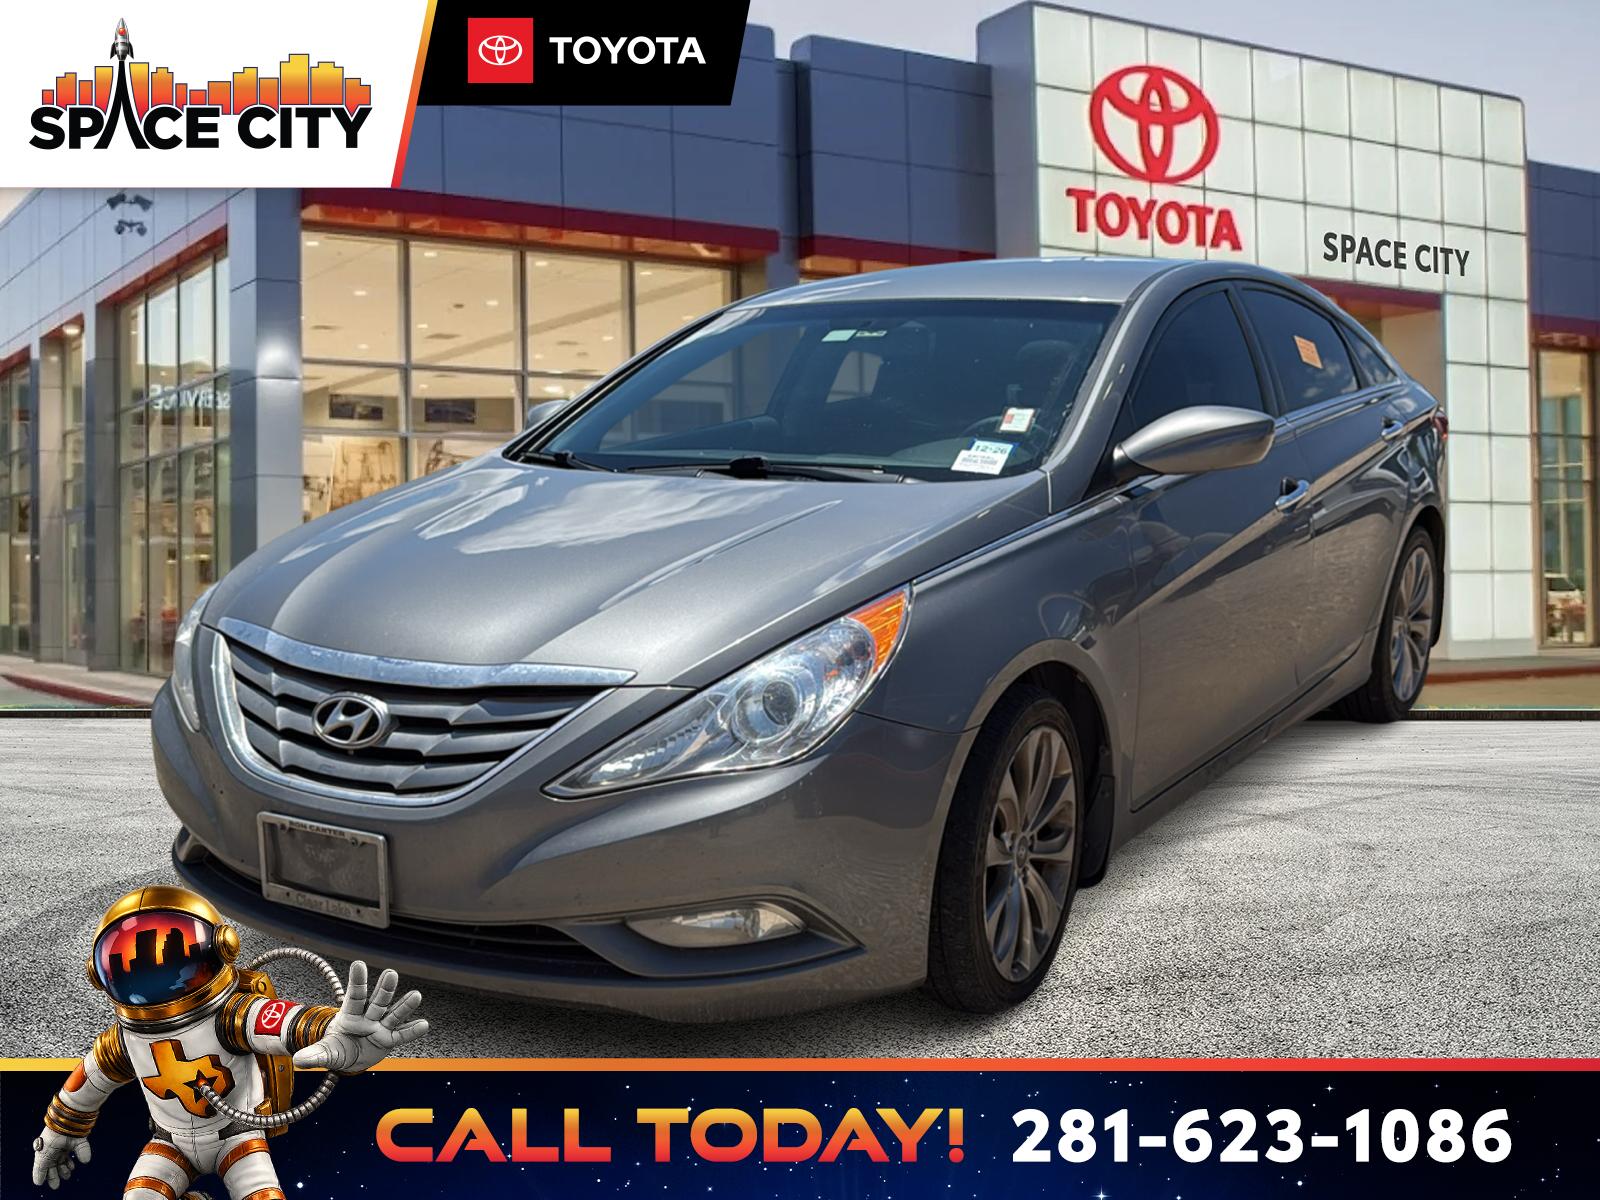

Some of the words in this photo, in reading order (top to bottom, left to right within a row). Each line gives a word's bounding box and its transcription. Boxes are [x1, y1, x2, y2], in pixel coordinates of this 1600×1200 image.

[1066, 187, 1242, 251] TOYOTA
[1323, 232, 1407, 270] SPACE
[1414, 244, 1470, 277] CITY
[326, 899, 353, 918] Lake
